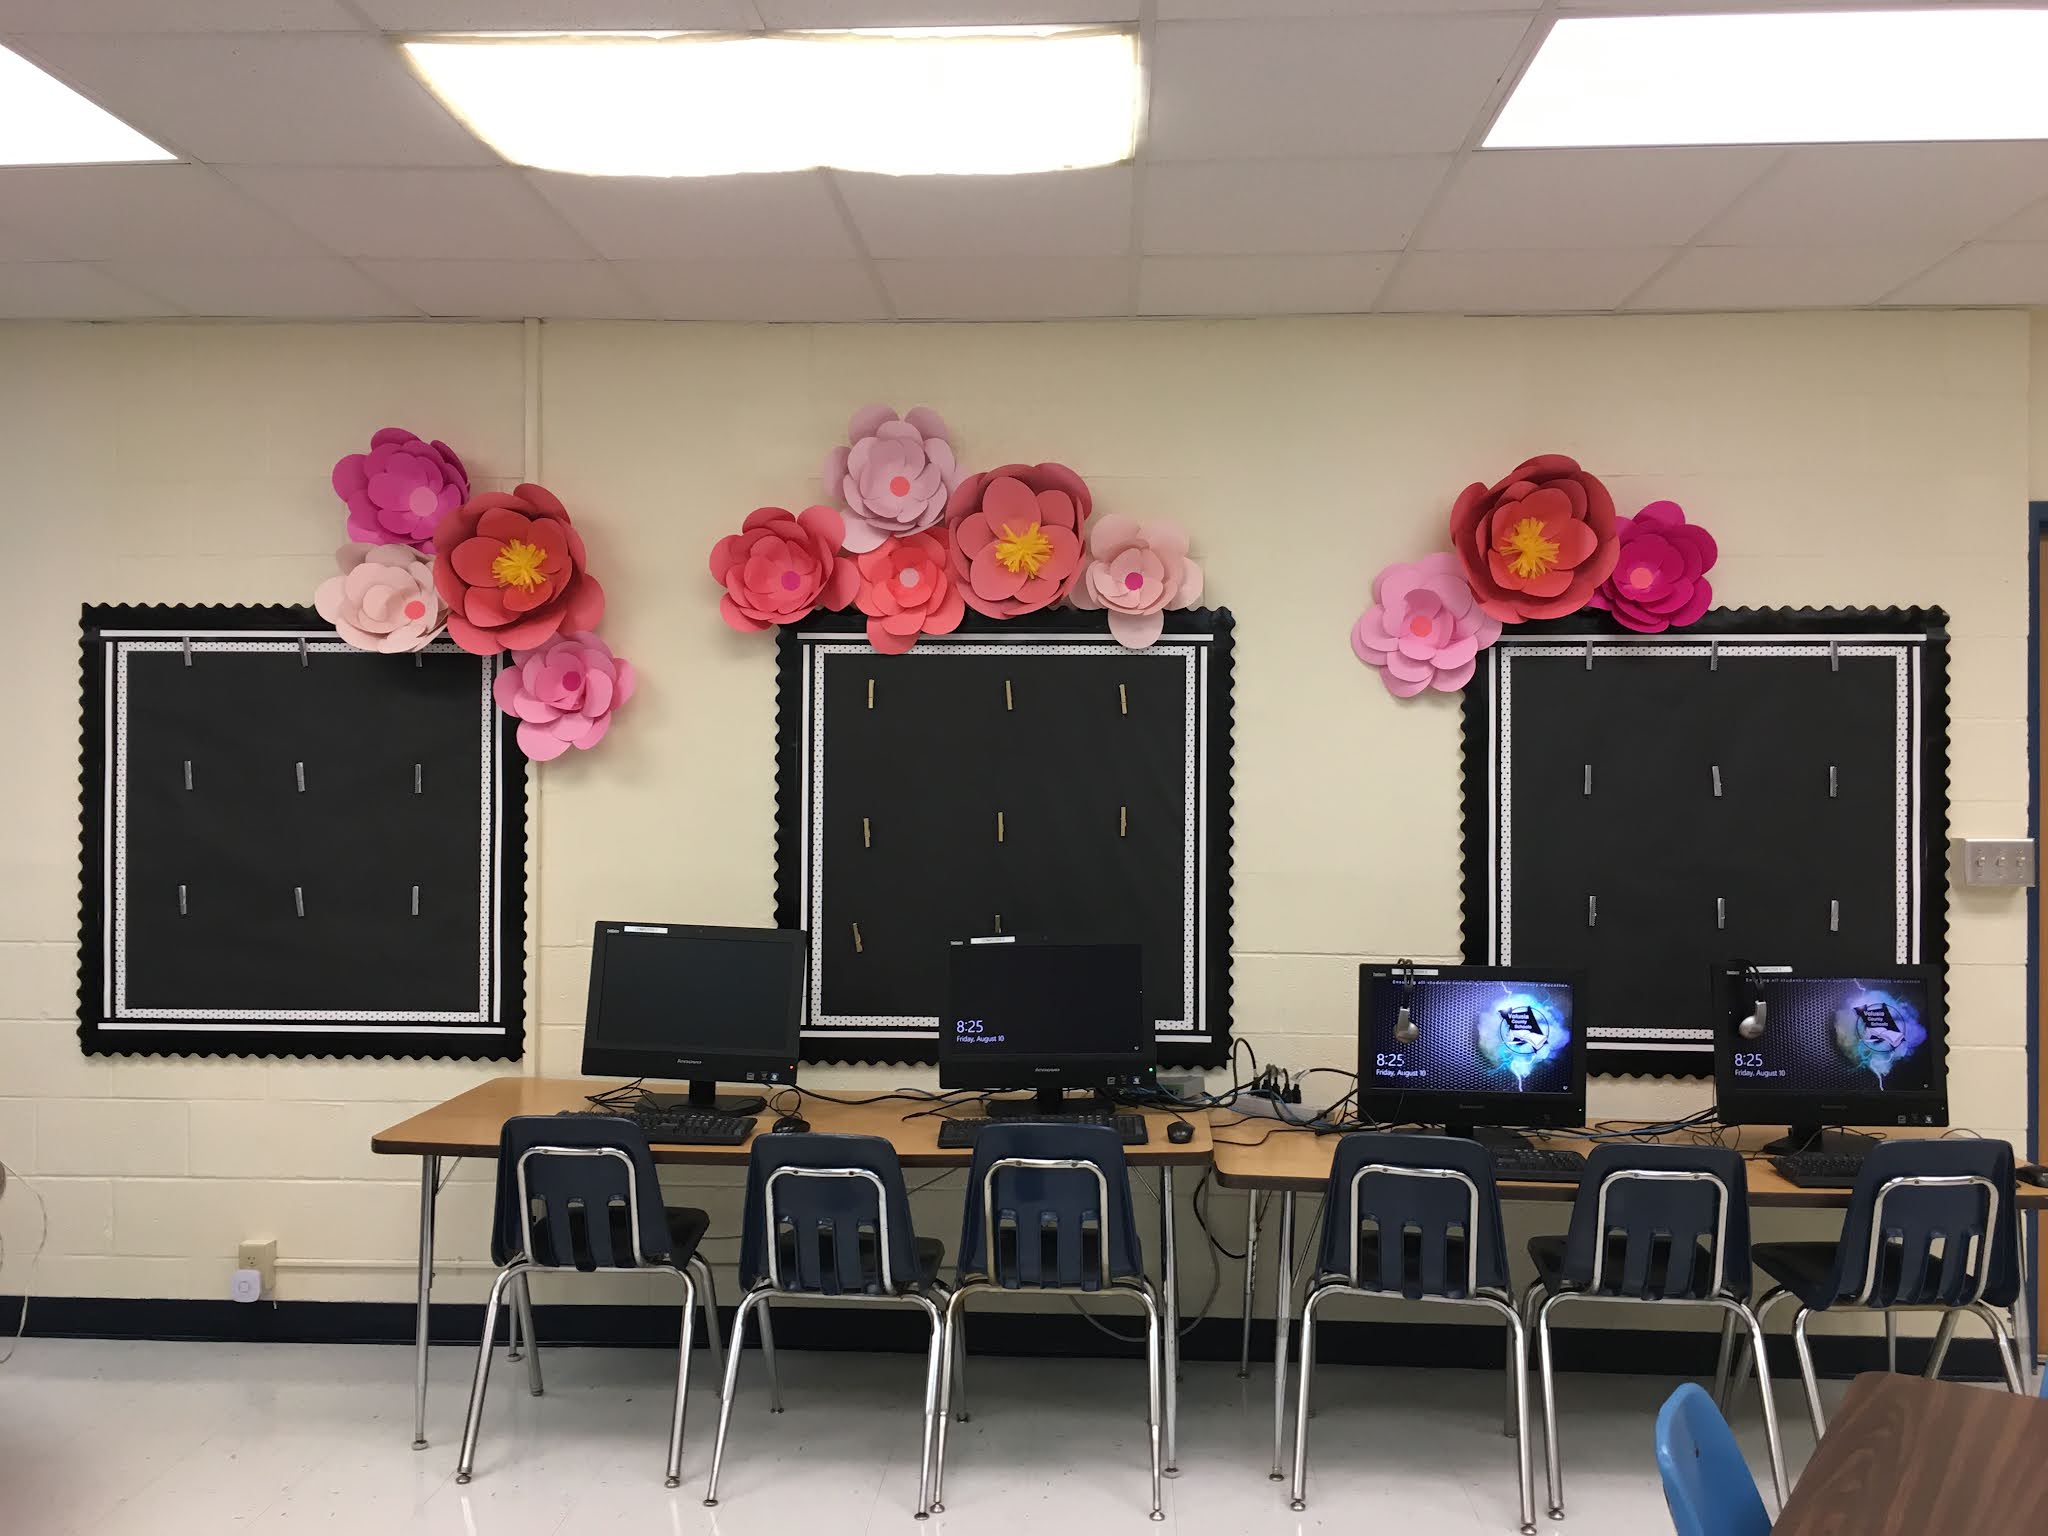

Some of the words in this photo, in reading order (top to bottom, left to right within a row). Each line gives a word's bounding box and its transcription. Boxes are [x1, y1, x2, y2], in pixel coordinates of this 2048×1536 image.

[956, 1020, 984, 1033] 8:25
[976, 1035, 997, 1043] August
[1376, 1053, 1405, 1066] 8:25
[1734, 1053, 1763, 1067] 8:25
[1375, 1069, 1396, 1077] Friday,
[1419, 1069, 1427, 1077] 10
[1734, 1069, 1755, 1077] Friday,
[1756, 1069, 1778, 1077] August
[1779, 1069, 1786, 1077] 10
